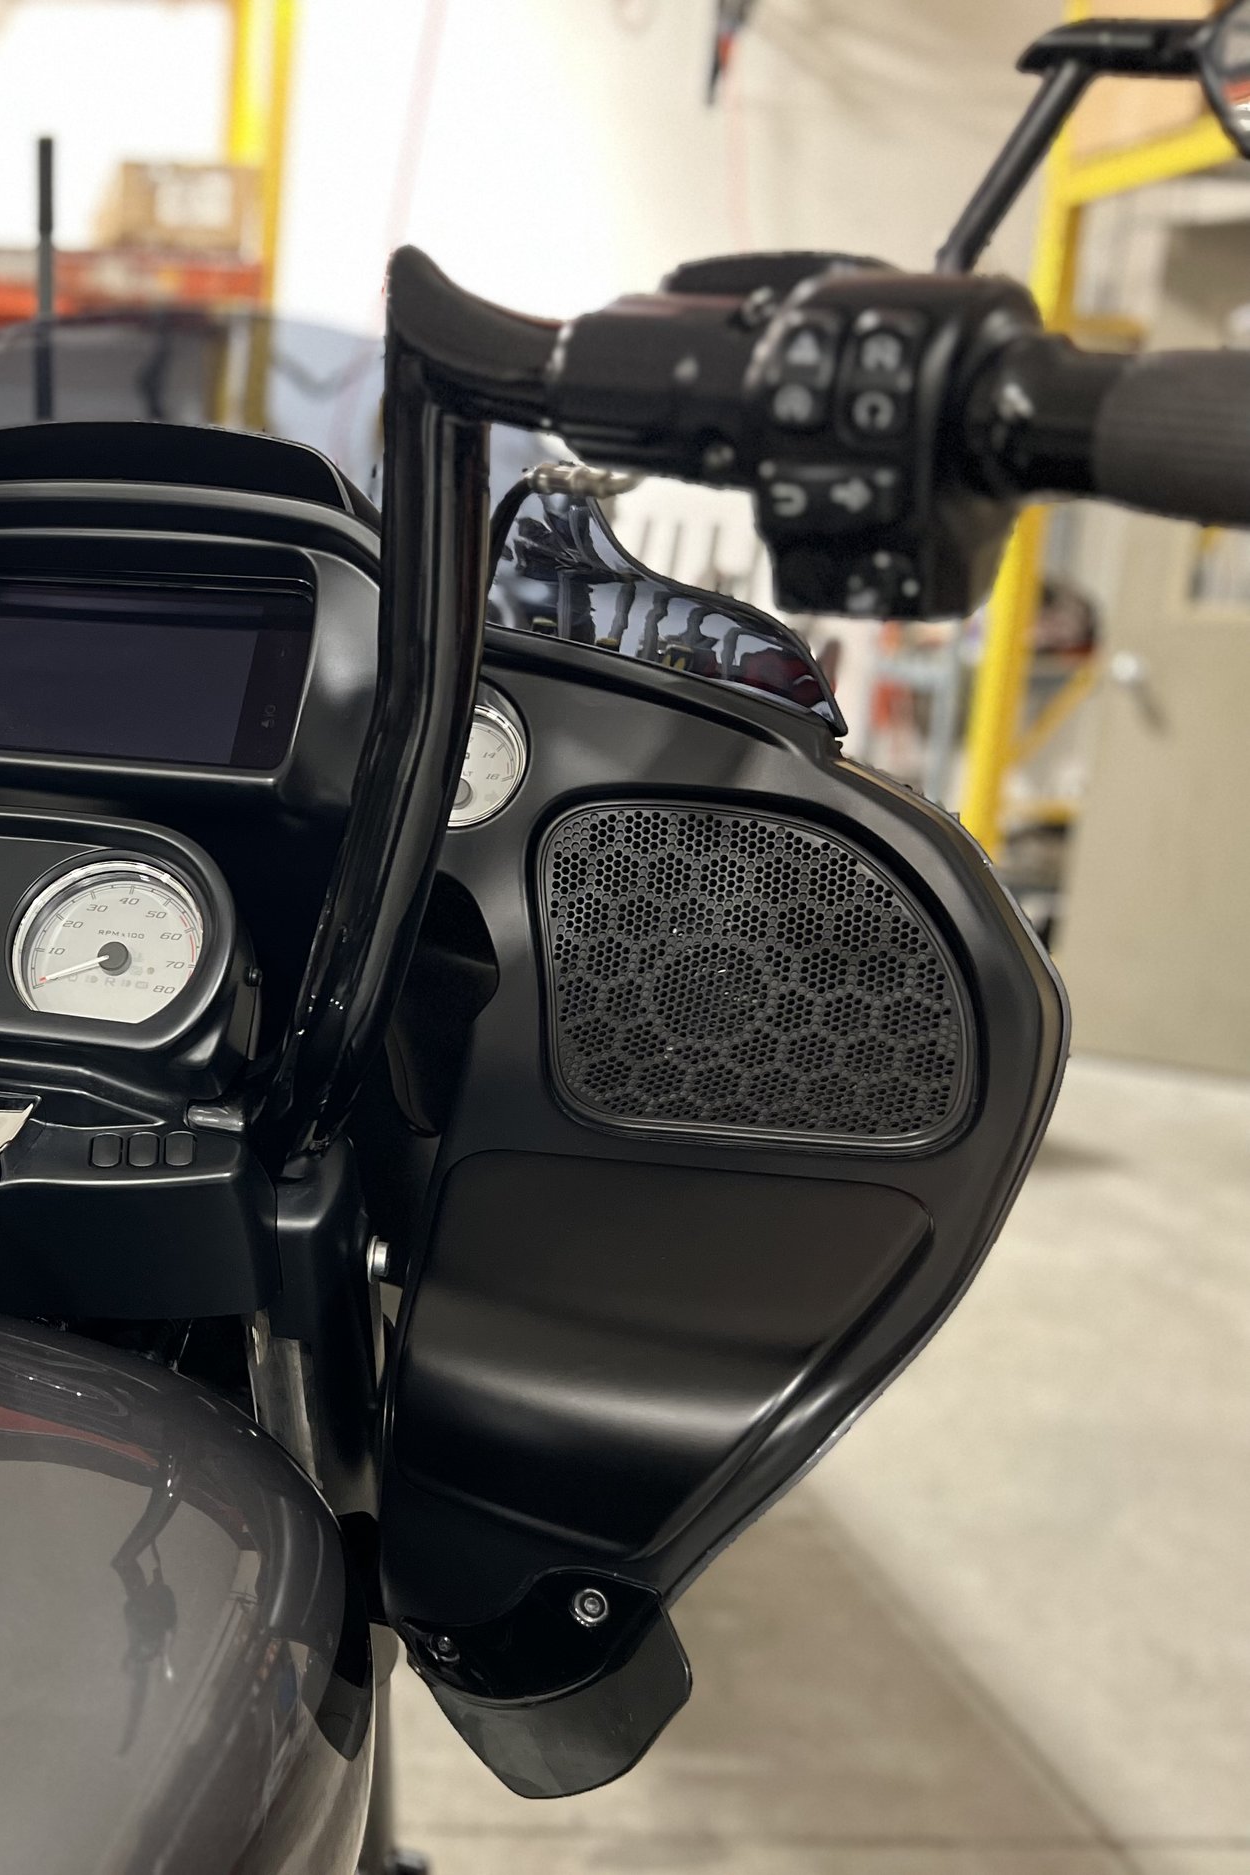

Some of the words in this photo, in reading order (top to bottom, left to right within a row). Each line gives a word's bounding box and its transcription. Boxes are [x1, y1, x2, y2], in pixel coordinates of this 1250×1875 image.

[119, 898, 140, 906] 40
[86, 904, 108, 913] 30
[145, 910, 168, 919] 50
[62, 920, 84, 929] 20
[160, 932, 182, 941] 60
[48, 947, 66, 955] 10
[165, 960, 185, 969] 70
[152, 985, 176, 994] 80
